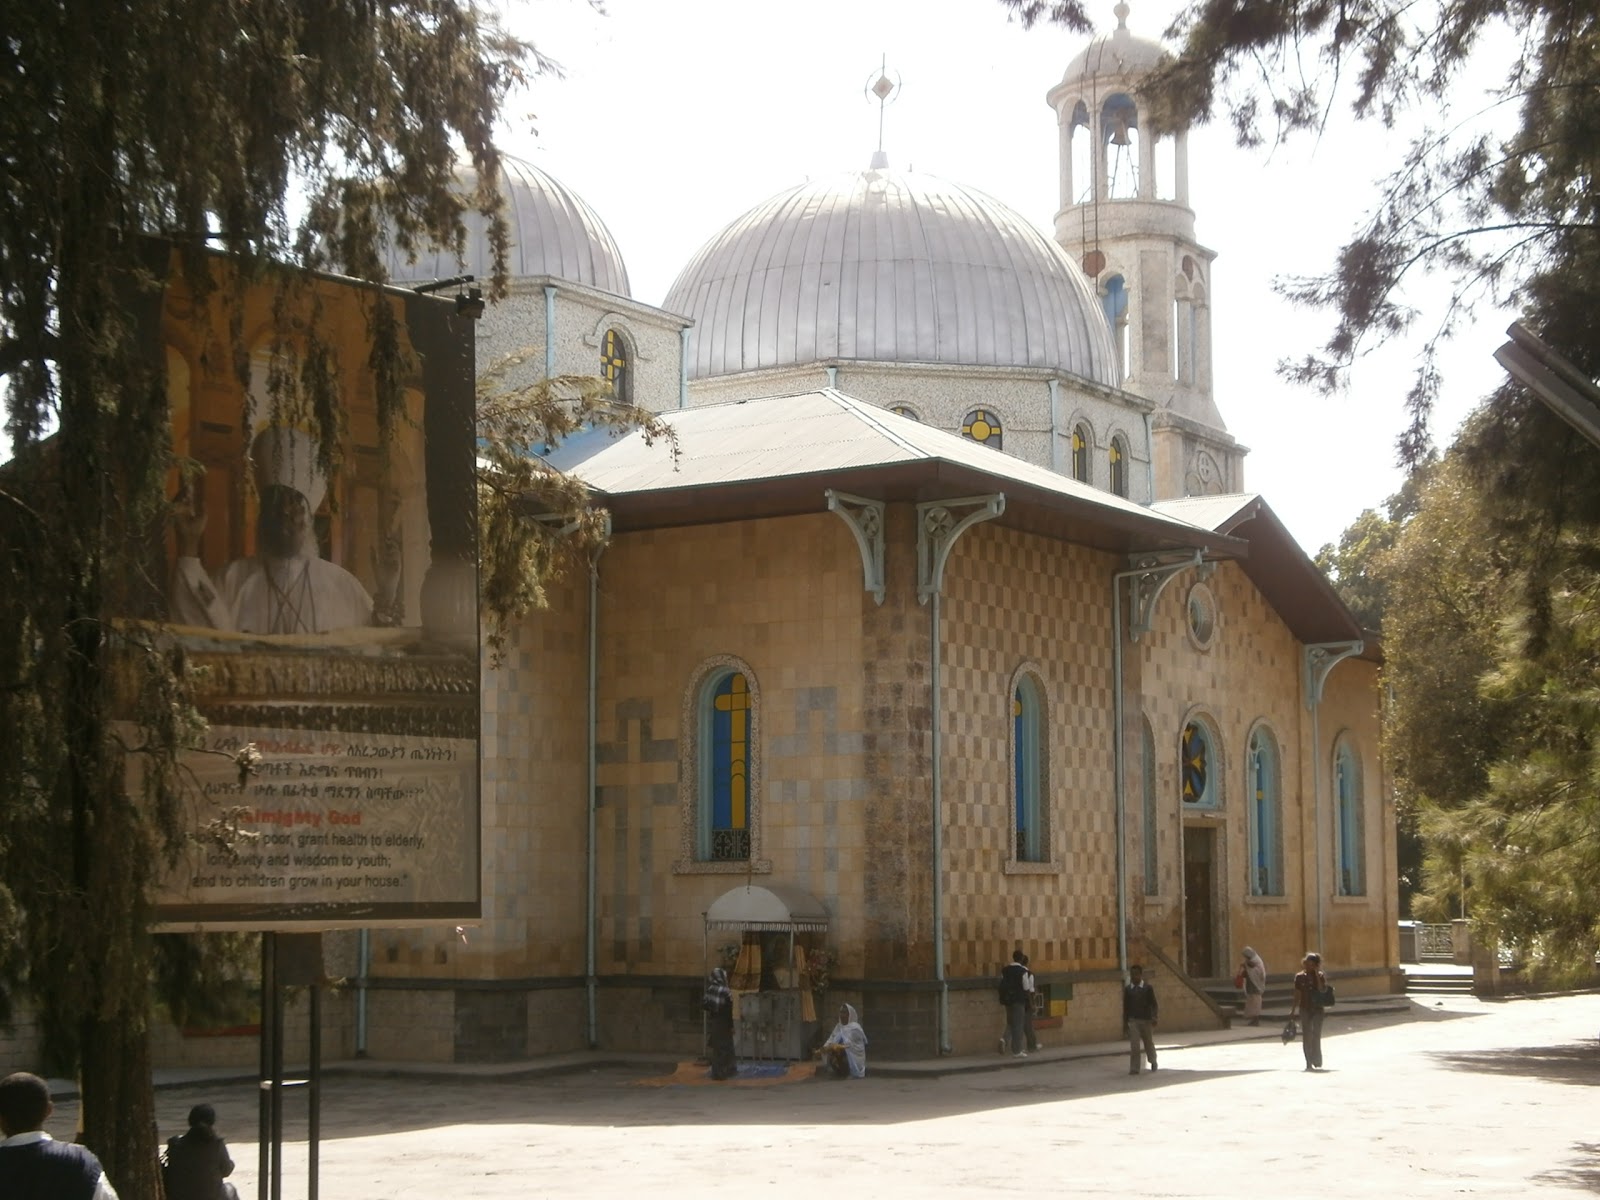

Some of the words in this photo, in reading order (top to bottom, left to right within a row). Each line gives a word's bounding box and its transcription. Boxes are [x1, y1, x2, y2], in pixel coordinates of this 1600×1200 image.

[328, 810, 361, 826] God
[263, 834, 294, 848] poor,
[297, 834, 329, 849] grant
[332, 833, 367, 847] health
[371, 834, 383, 847] to
[385, 833, 425, 850] elderly,
[267, 853, 289, 866] and
[294, 853, 339, 867] wisdom
[342, 855, 353, 867] to
[357, 854, 392, 870] youth;
[192, 875, 216, 888] and
[220, 876, 232, 888] to
[236, 874, 286, 888] children
[289, 876, 318, 891] grow
[321, 874, 333, 888] in
[336, 876, 362, 891] your
